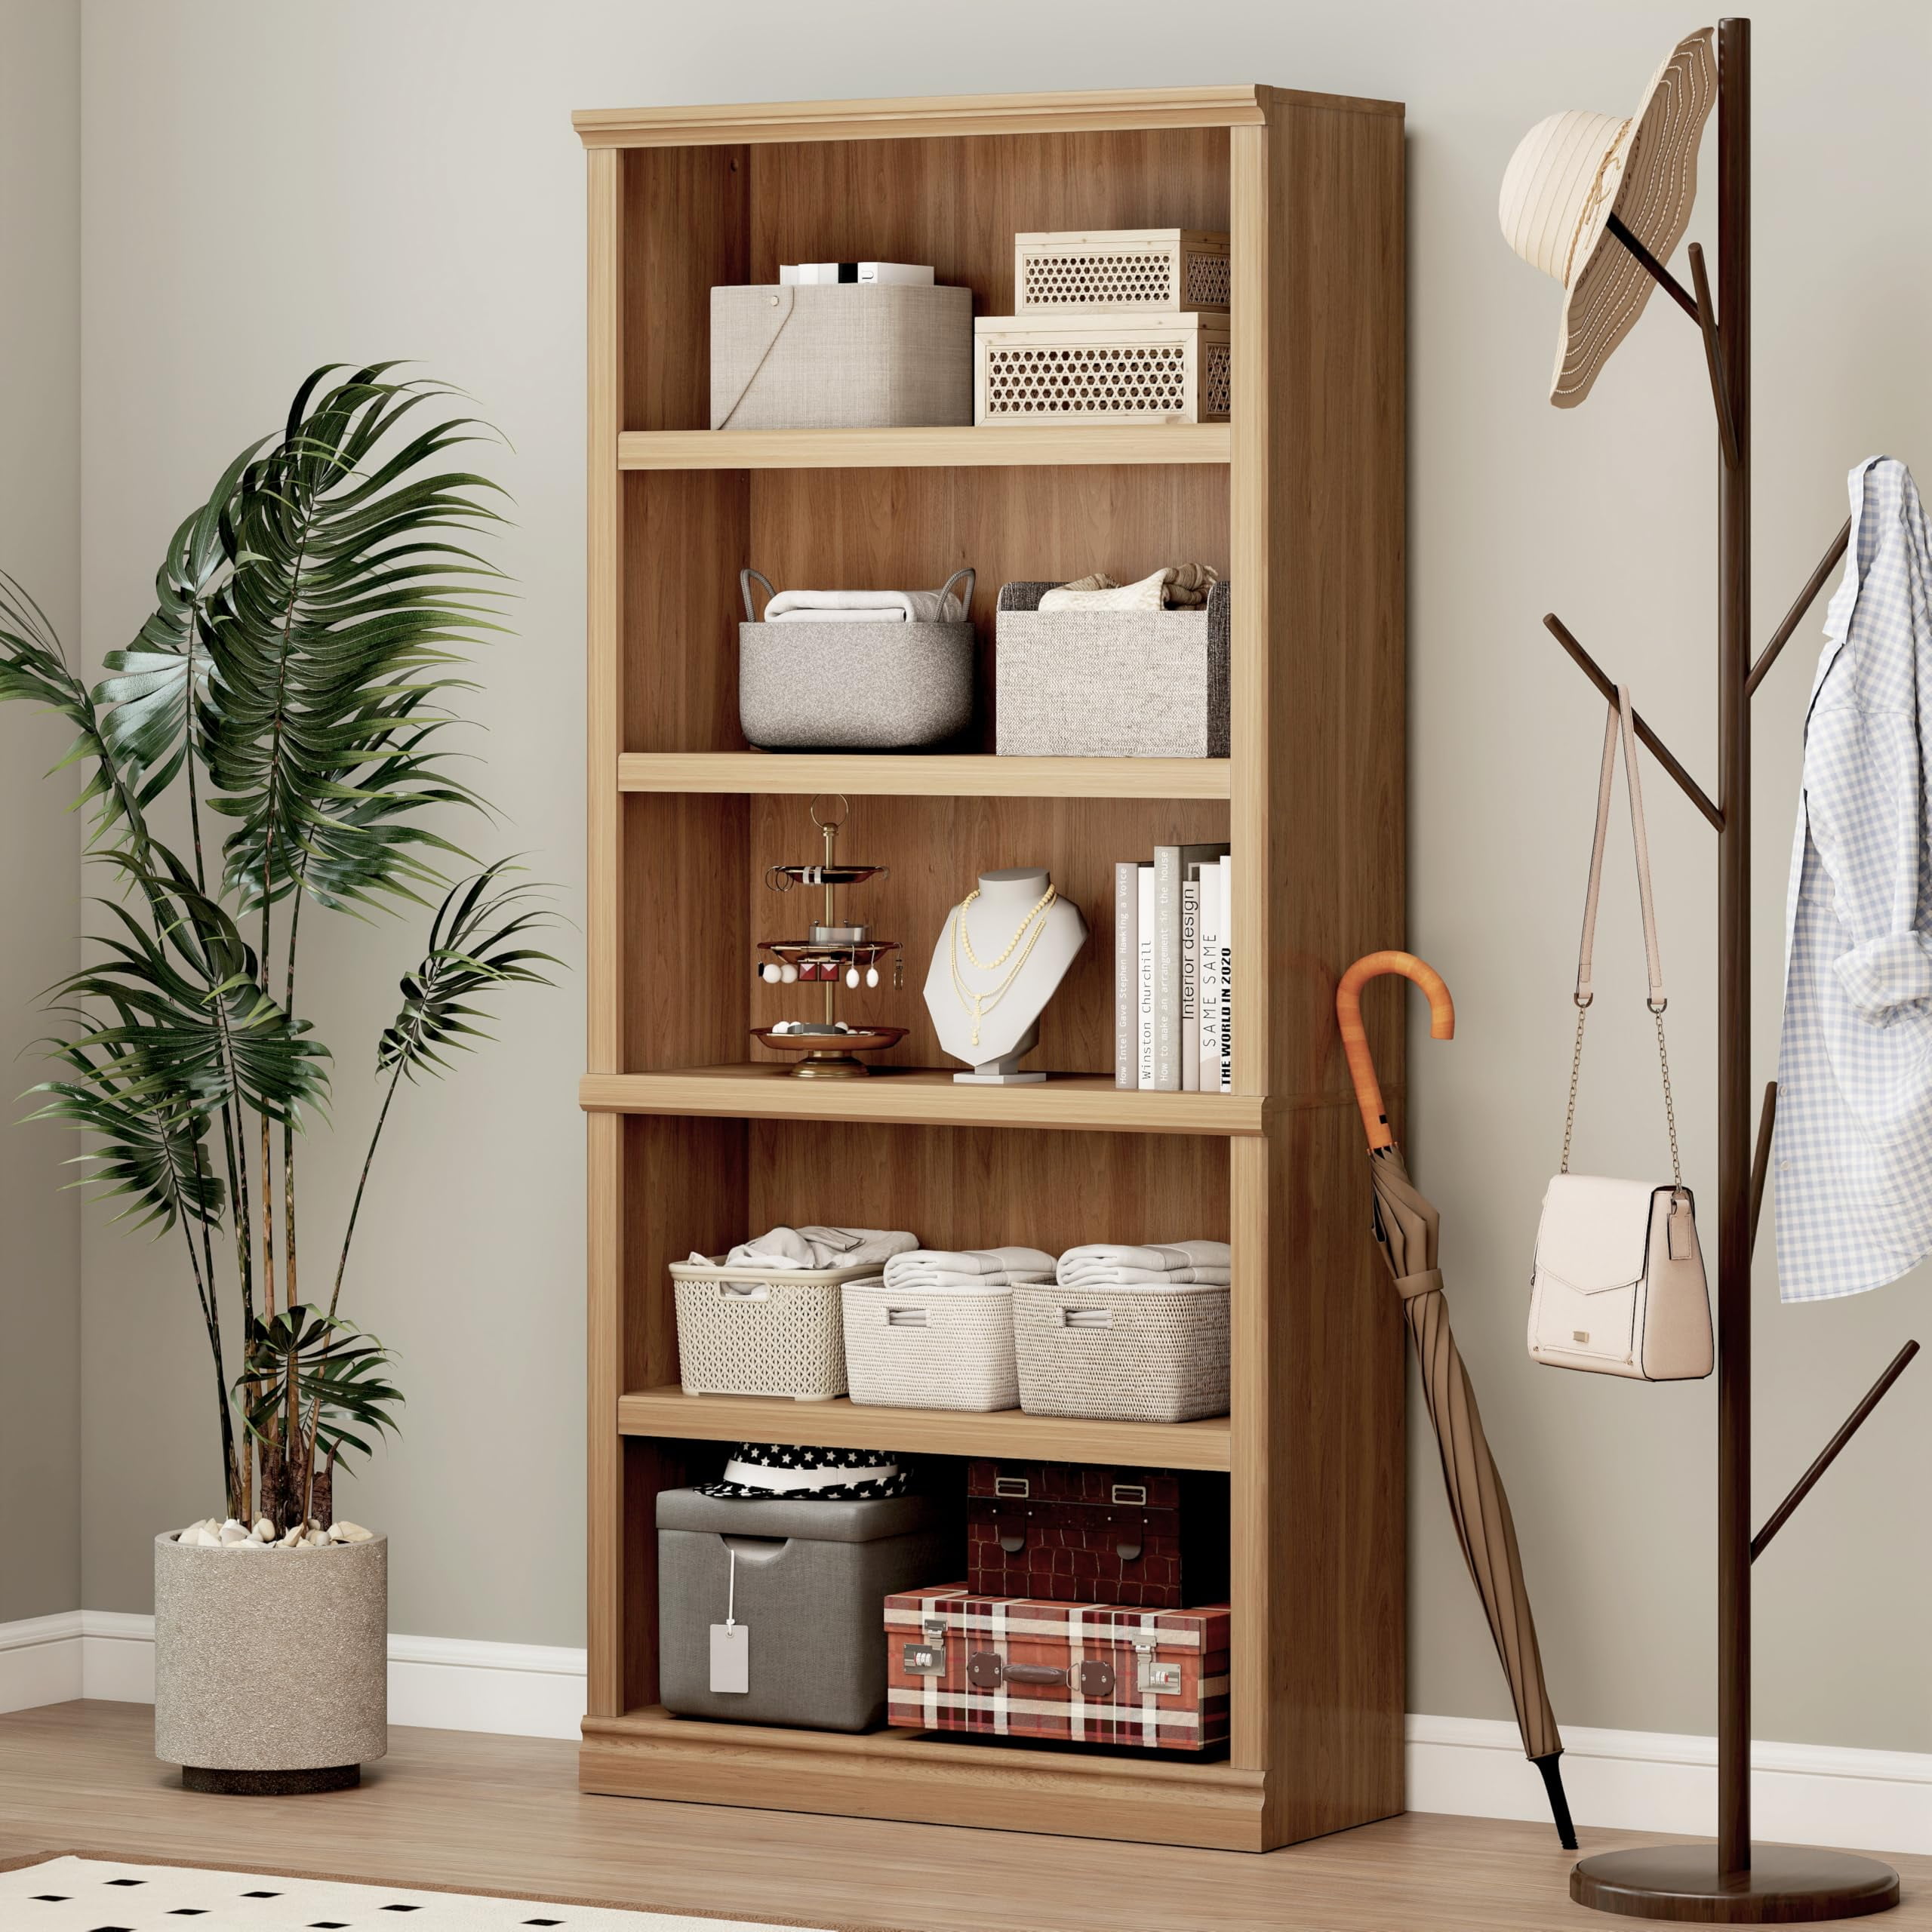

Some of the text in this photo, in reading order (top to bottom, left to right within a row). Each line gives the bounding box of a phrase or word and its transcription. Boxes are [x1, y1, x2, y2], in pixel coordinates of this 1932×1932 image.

[1159, 851, 1168, 881] house
[1159, 887, 1168, 904] the
[1119, 912, 1128, 953] Hawking
[1161, 929, 1171, 992] arrangement
[1183, 888, 1198, 1019] Interior design
[1119, 960, 1128, 998] Stephen
[1203, 934, 1217, 1047] SAME SAME
[1141, 941, 1151, 1079] Winston Churchill
[1161, 998, 1168, 1011] an
[1221, 948, 1231, 1086] THE WORLD IN 2020
[1160, 1017, 1168, 1041] make
[1161, 1045, 1168, 1057] to
[1160, 1063, 1168, 1081] How
